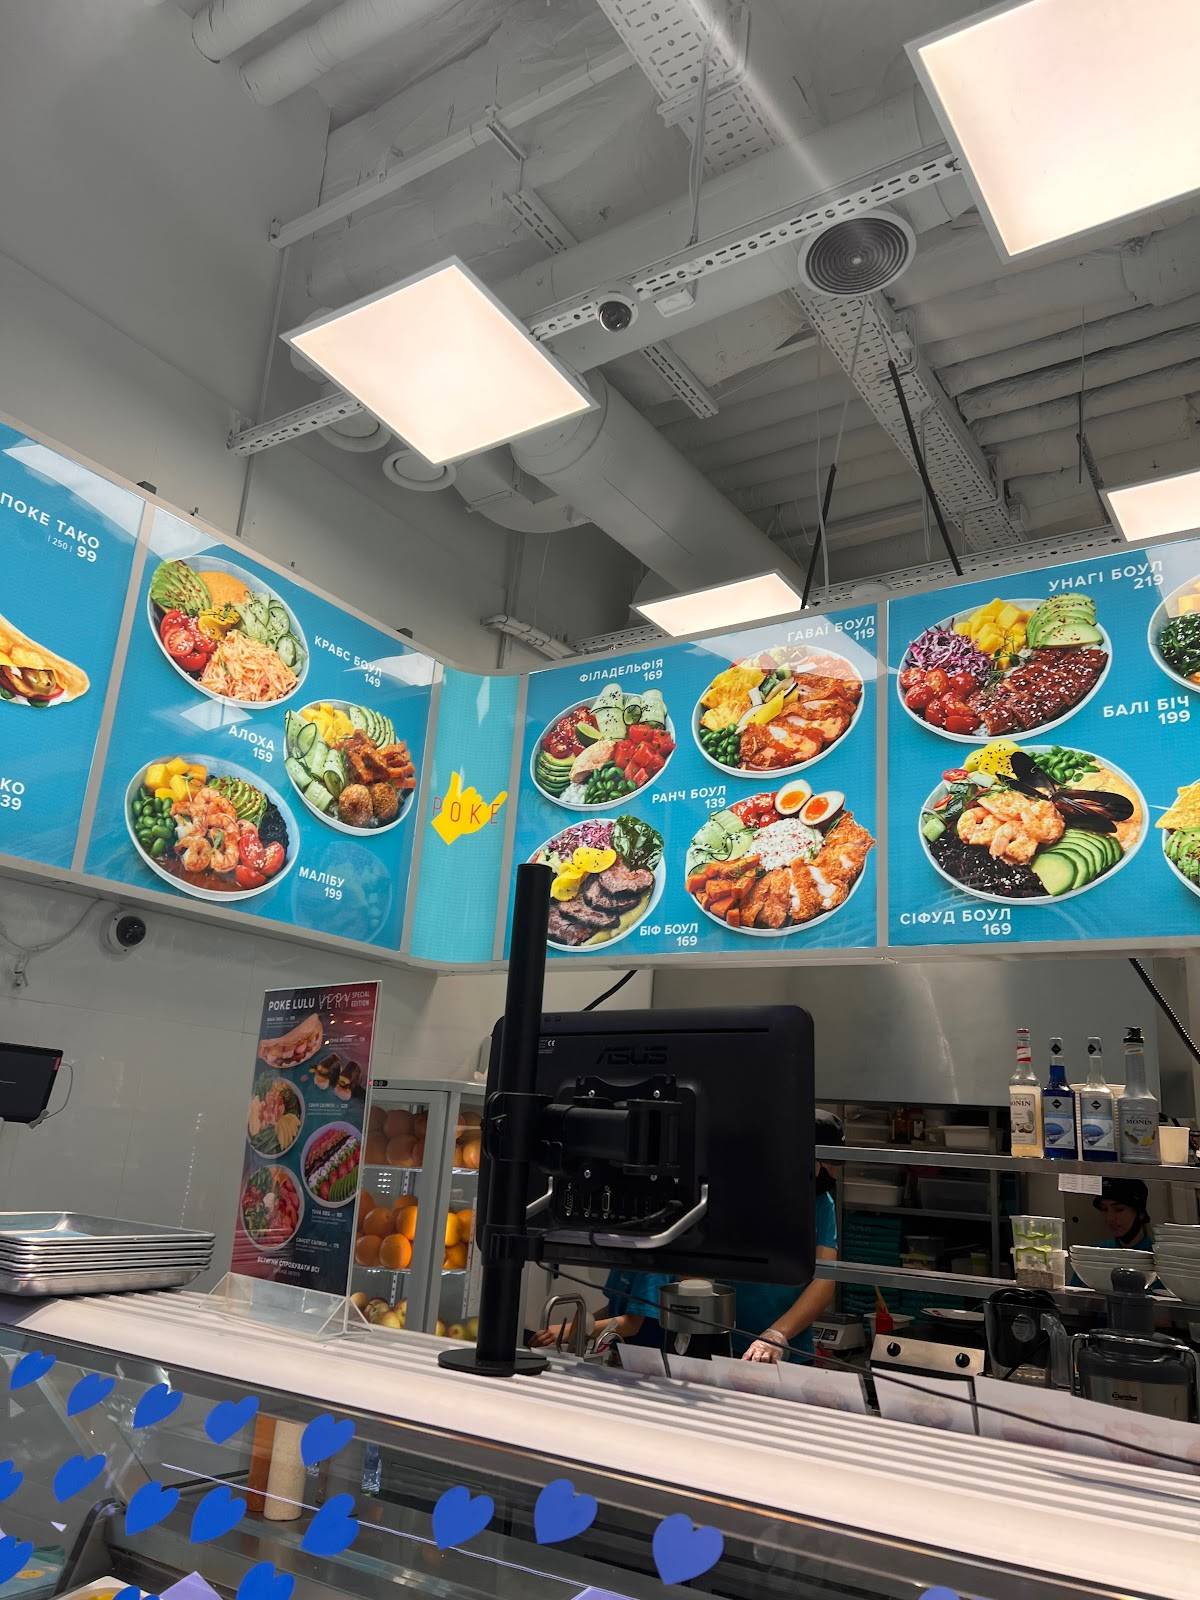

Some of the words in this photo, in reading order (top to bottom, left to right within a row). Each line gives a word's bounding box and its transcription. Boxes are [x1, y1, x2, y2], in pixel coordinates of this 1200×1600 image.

[0, 492, 50, 526] ПОКЕ
[57, 519, 100, 549] ТАКО
[76, 545, 97, 563] 99
[1049, 572, 1104, 594] УНАГІ
[1111, 560, 1163, 581] БОУЛ
[1133, 573, 1164, 591] 219
[787, 623, 830, 643] ГАВАЇ
[835, 615, 875, 633] БОУЛ
[853, 627, 875, 641] 119
[314, 635, 351, 662] КРАБС
[354, 655, 383, 678] БОУЛ
[579, 658, 664, 684] ФІЛАДЕЛЬФІЯ
[643, 669, 663, 682] 169
[364, 672, 382, 689] 149
[1103, 701, 1149, 718] БАЛІ
[1157, 695, 1190, 711] БІЧ
[1157, 709, 1191, 725] 199
[228, 723, 276, 753] АЛОХА
[253, 745, 274, 763] 159
[652, 790, 686, 804] РАНЧ
[691, 786, 726, 800] БОУЛ
[704, 796, 727, 810] 139
[432, 795, 500, 825] POKE
[298, 866, 345, 889] МАЛІБУ
[324, 886, 343, 902] 199
[900, 910, 956, 925] СІФУД
[962, 907, 1011, 922] БОУЛ
[639, 924, 662, 937] БІФ
[664, 922, 699, 936] БОУЛ
[982, 922, 1012, 936] 169
[676, 936, 698, 947] 169
[268, 999, 291, 1011] POKE
[293, 997, 315, 1009] LULU
